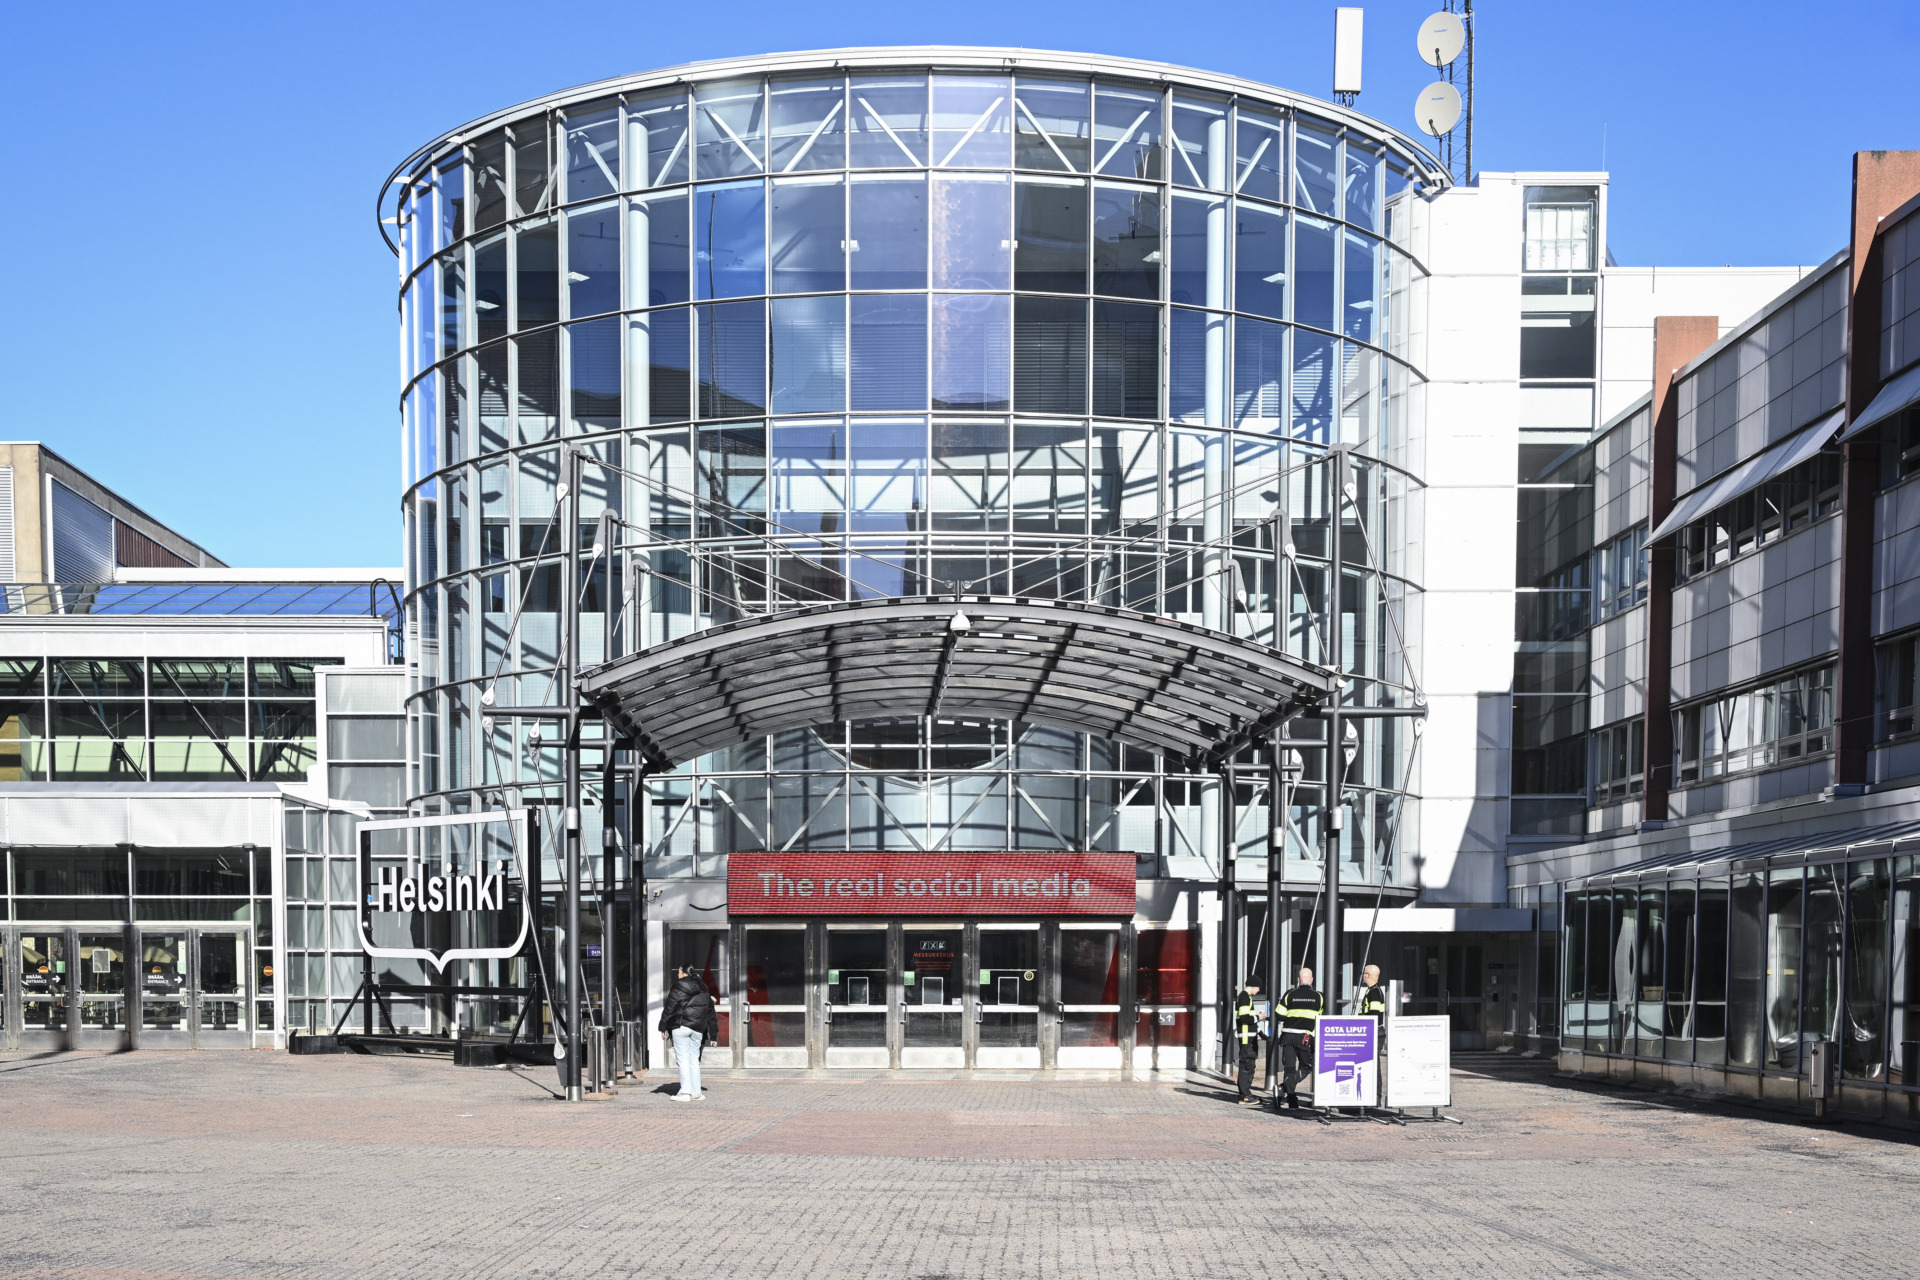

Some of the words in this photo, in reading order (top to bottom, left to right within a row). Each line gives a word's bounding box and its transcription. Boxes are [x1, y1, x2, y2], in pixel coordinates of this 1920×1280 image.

[378, 860, 503, 912] Helsinki
[757, 873, 814, 897] The
[824, 873, 884, 897] real
[893, 872, 982, 897] social
[992, 872, 1090, 897] media
